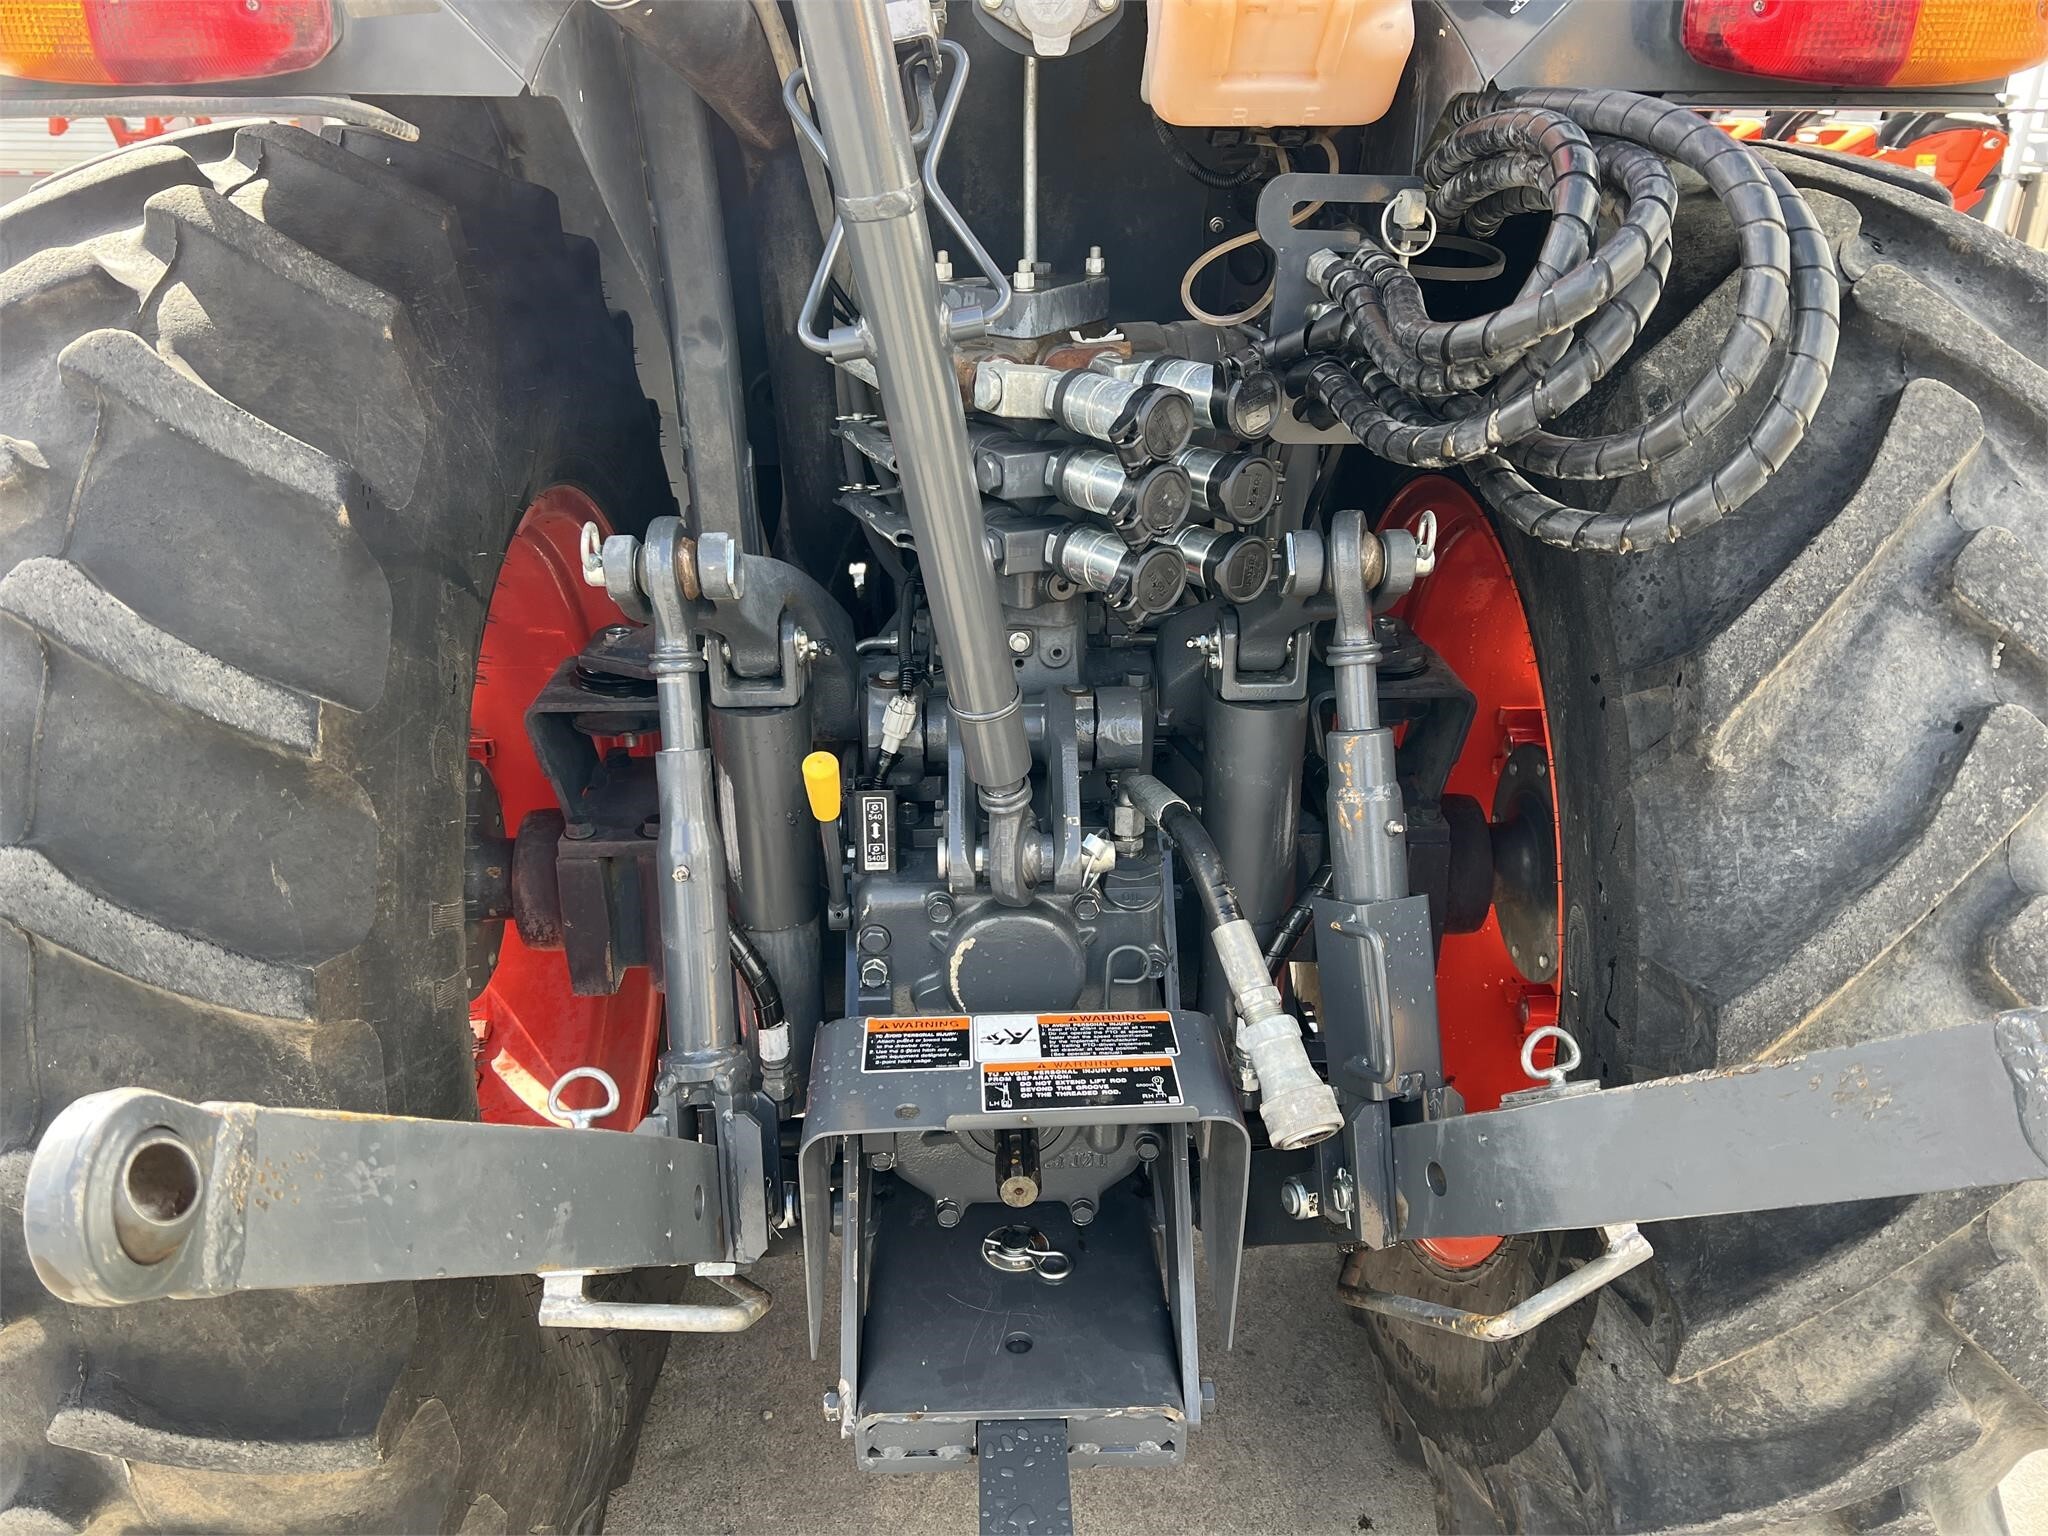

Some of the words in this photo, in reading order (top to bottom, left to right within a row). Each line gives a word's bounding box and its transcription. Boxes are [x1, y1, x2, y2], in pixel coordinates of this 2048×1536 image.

[868, 813, 883, 821] 540
[867, 854, 886, 862] 540E
[1122, 891, 1144, 904] OIL
[1079, 1014, 1147, 1022] WARNING
[892, 1020, 960, 1029] WARNING
[1054, 1060, 1120, 1068] WARNING
